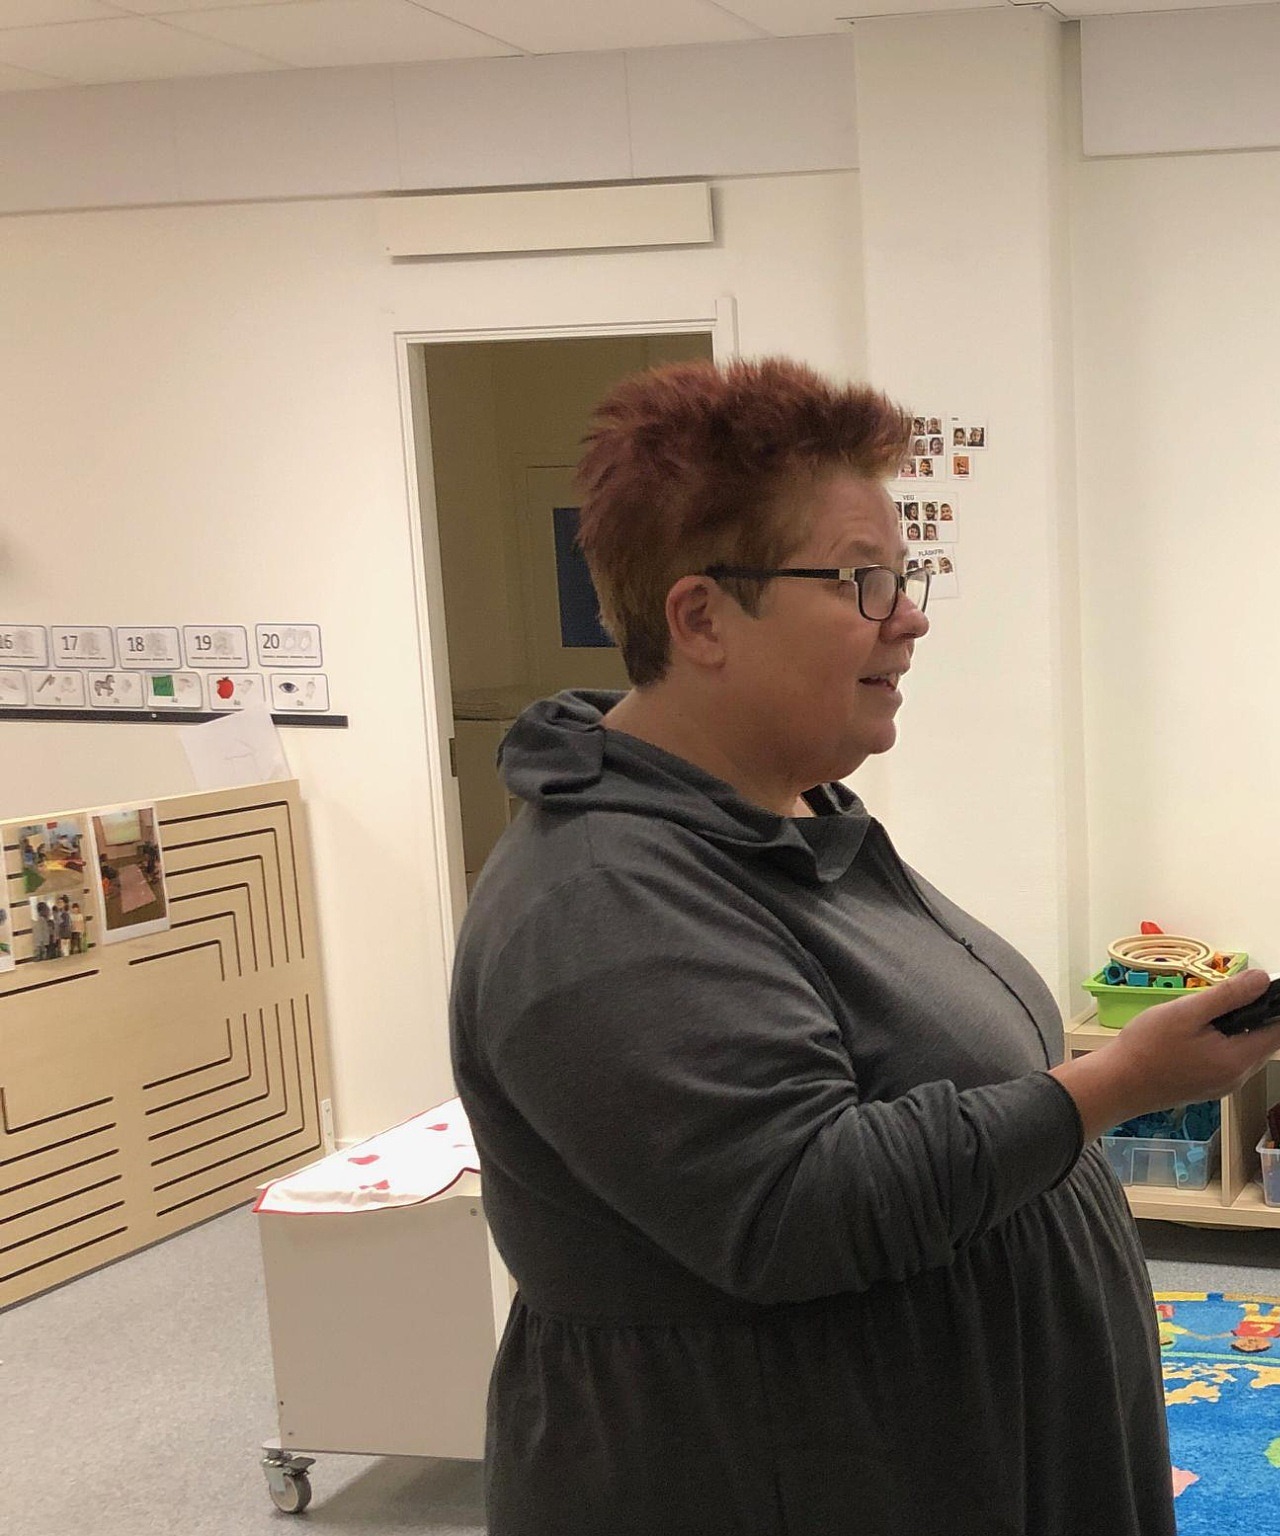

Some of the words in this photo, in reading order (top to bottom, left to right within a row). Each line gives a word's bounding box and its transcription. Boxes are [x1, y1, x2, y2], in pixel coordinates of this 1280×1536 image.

[61, 635, 78, 651] 17
[127, 636, 145, 652] 18
[195, 635, 212, 651] 19
[261, 633, 280, 649] 20
